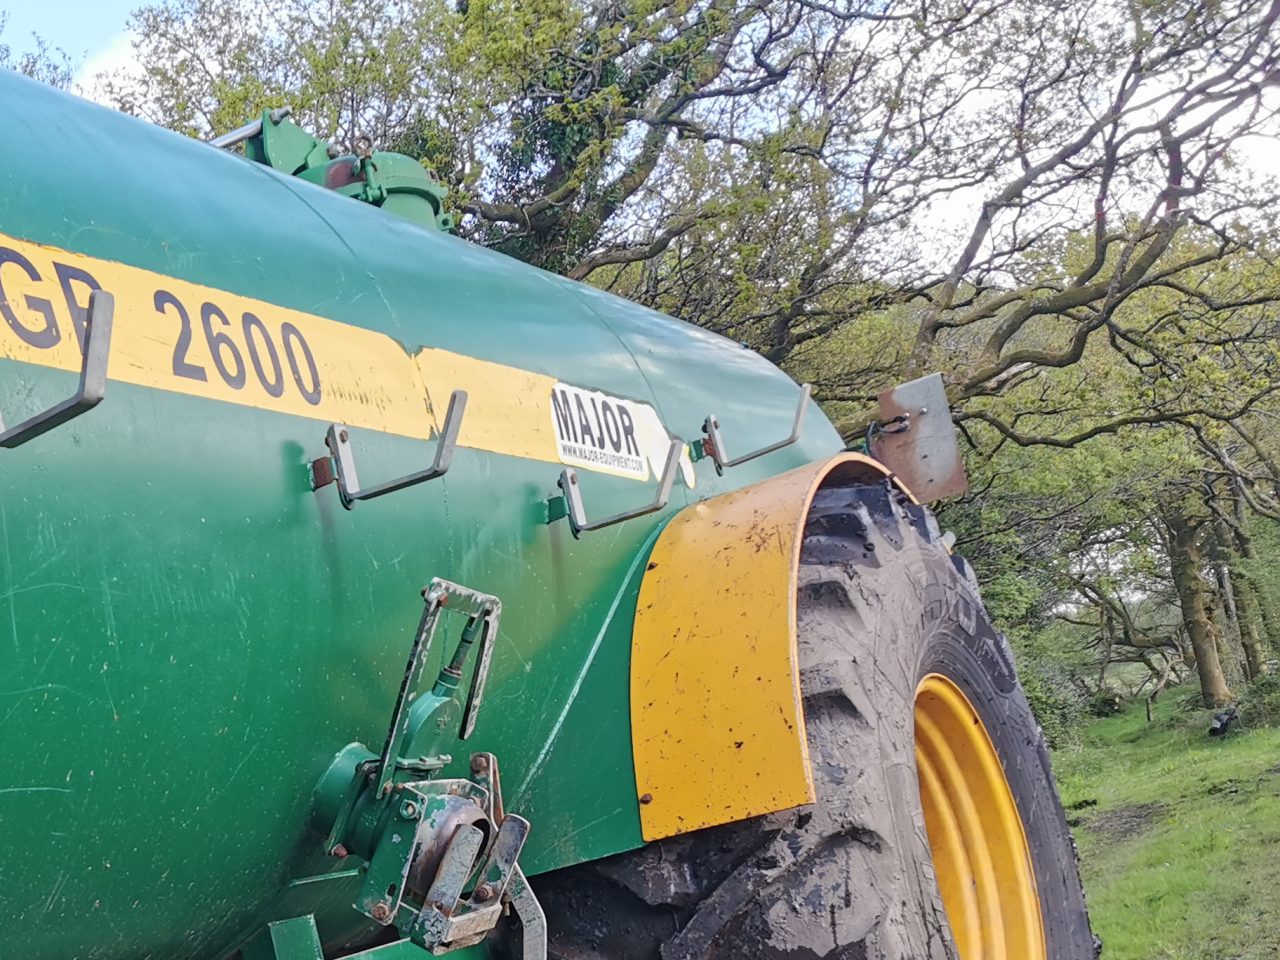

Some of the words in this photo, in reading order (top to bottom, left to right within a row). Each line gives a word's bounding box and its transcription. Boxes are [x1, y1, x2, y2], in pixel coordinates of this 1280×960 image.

[153, 290, 322, 406] 2600
[551, 388, 640, 457] MAJOR
[562, 444, 644, 472] WWW.MAJOR-EQUIPMENT.COM
